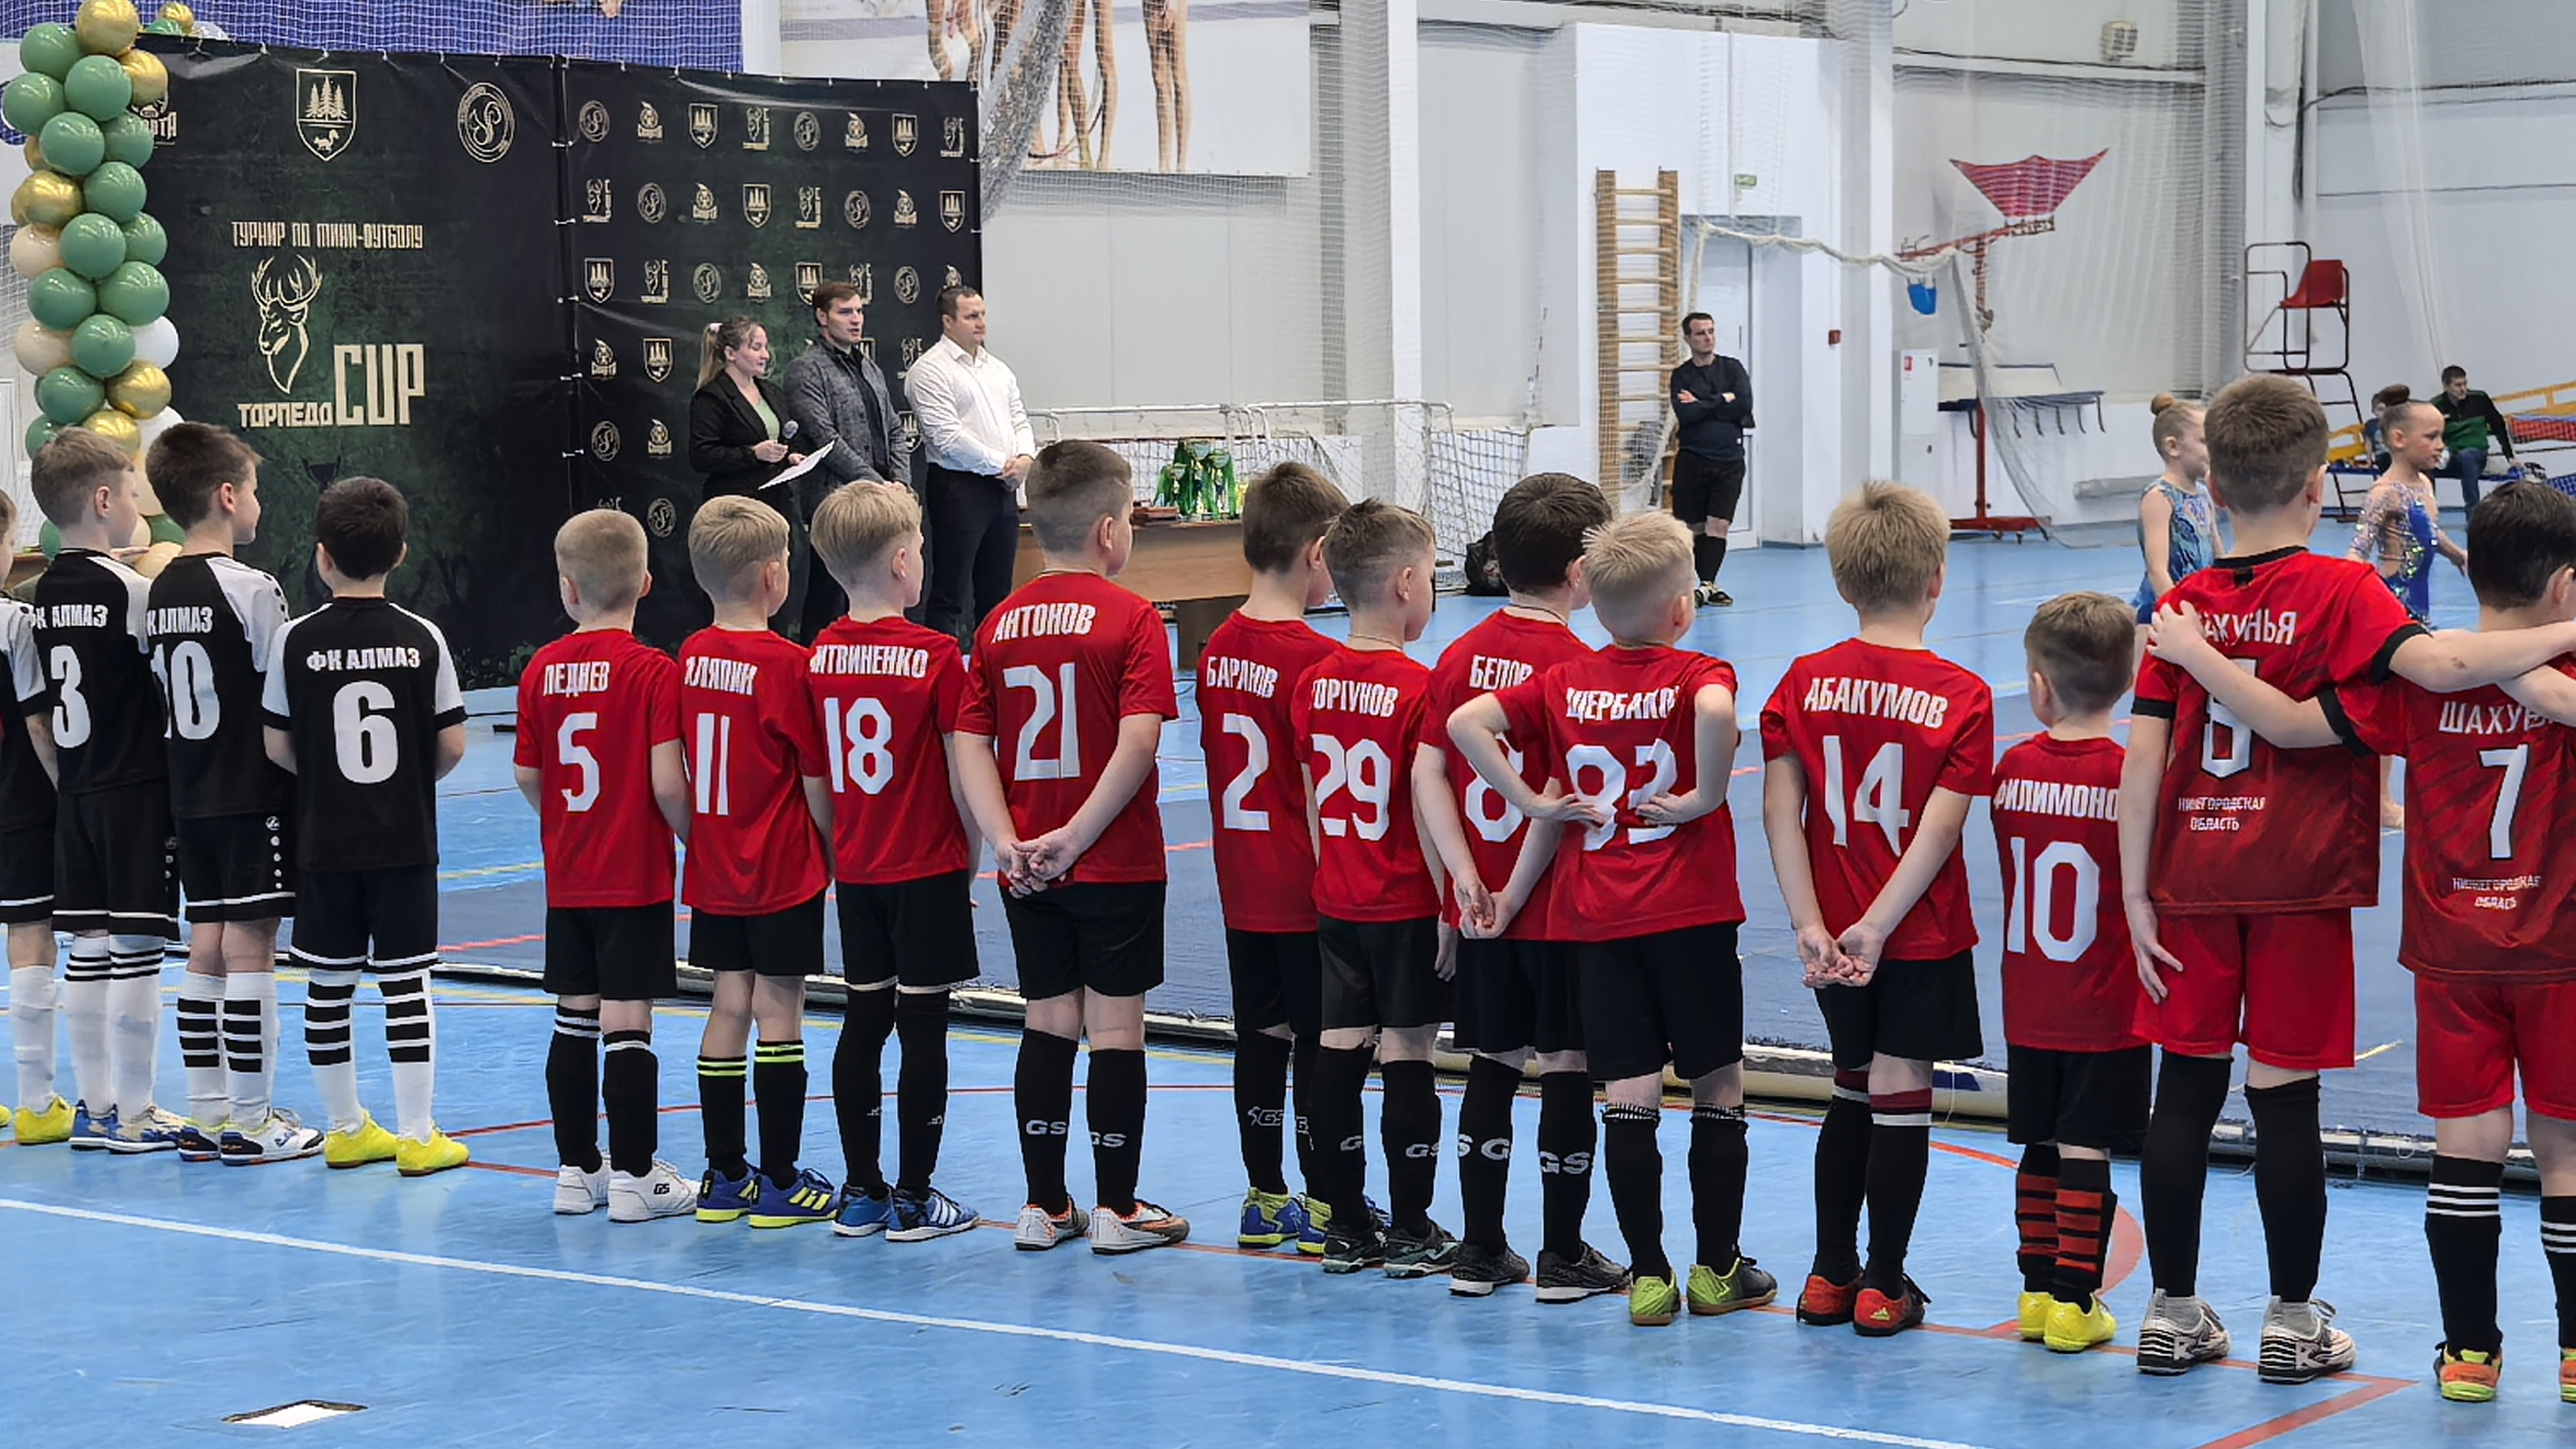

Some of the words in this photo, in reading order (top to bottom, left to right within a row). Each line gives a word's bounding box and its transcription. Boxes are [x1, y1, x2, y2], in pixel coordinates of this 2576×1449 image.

[231, 222, 286, 247] ТУРНИР
[292, 222, 311, 247] ПО
[237, 401, 334, 428] ТОРПЕДО
[334, 343, 425, 426] CUP
[52, 604, 109, 628] АЛМАЗ
[158, 606, 214, 635] АЛМАЗ
[991, 602, 1096, 644] АНТОНОВ
[51, 645, 91, 749] 3
[150, 640, 221, 740] 10
[306, 649, 342, 672] ФК
[346, 646, 421, 670] АЛМАЗ
[543, 661, 610, 697] ЛЕДНЕВ
[809, 644, 930, 679] ИТВИНЕНКО
[1207, 657, 1278, 699] БАРАНОВ
[1311, 677, 1399, 718] ОРГУНОВ
[333, 680, 398, 784] 6
[1003, 661, 1081, 781] 21
[1804, 677, 1948, 728] АБАКУМОВ
[557, 711, 600, 812] 5
[695, 713, 730, 815] 11
[823, 697, 894, 795] 18
[1222, 713, 1270, 831] 2
[1311, 734, 1392, 841] 29
[1823, 735, 1911, 858] 14
[2478, 743, 2529, 859] 7
[2007, 836, 2101, 963] 10
[1025, 1120, 1067, 1136] GS
